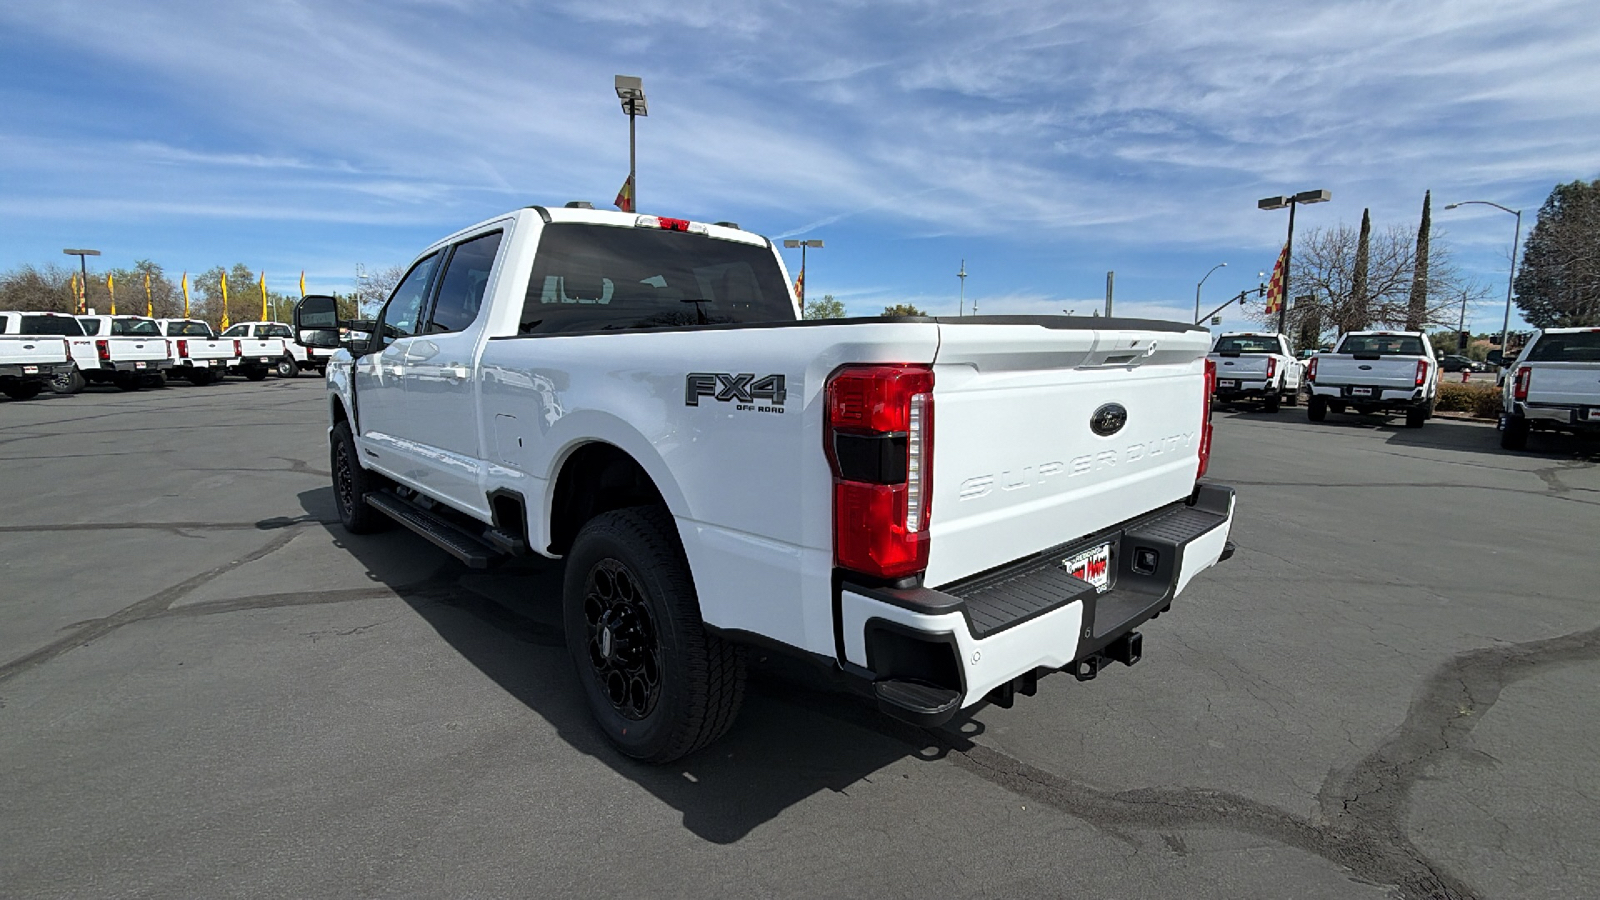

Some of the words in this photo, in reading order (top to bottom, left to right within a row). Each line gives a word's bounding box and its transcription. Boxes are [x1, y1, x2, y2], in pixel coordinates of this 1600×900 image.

[685, 372, 787, 407] FX4
[736, 404, 755, 412] OFF
[757, 406, 785, 414] ROAD
[959, 449, 1117, 502] SUPER
[1126, 431, 1195, 464] DUTY
